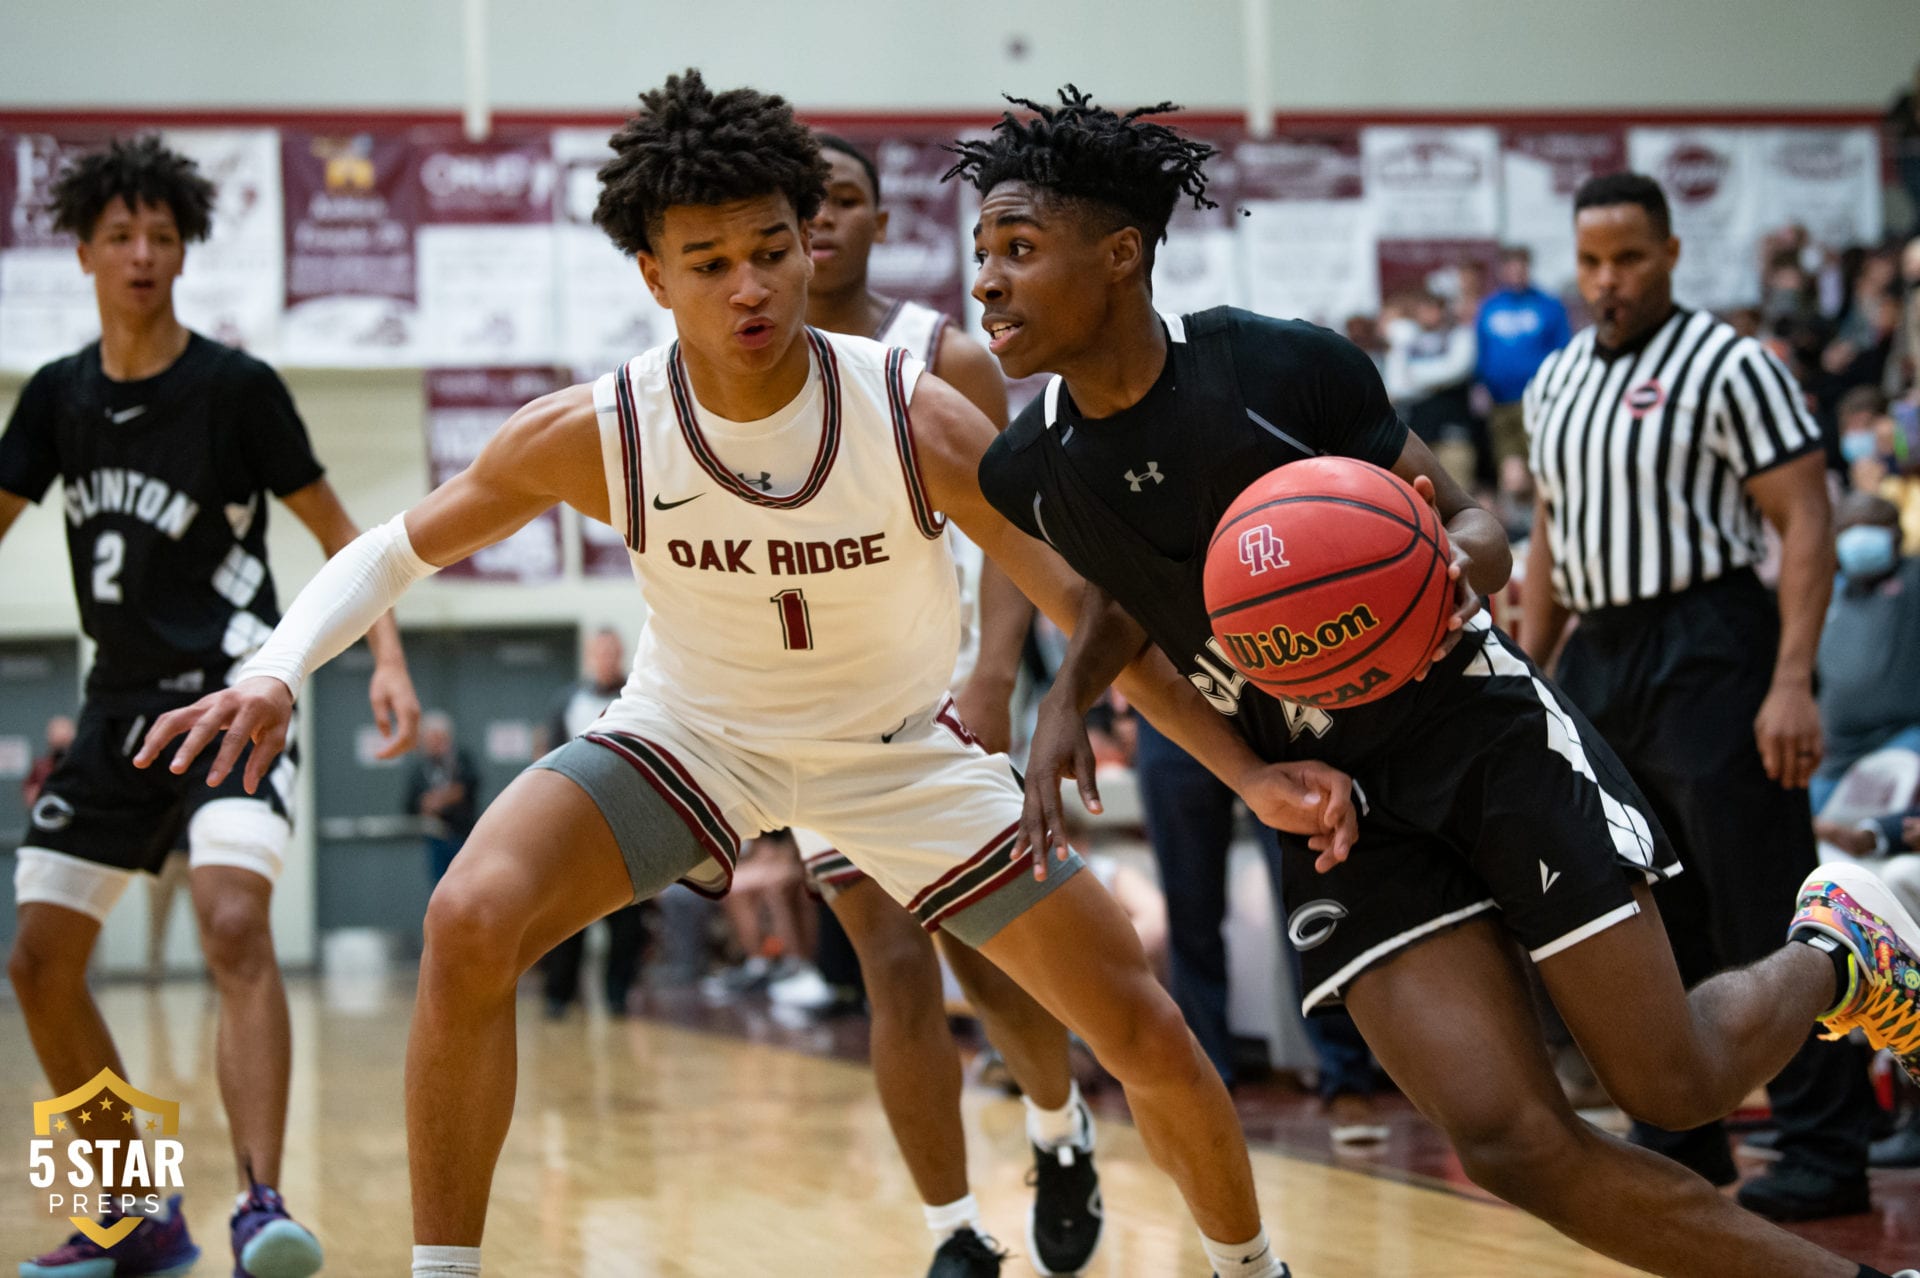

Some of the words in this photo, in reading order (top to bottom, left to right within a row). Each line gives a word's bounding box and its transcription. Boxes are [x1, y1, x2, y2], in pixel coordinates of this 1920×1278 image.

[64, 467, 199, 541] CLINTON
[91, 529, 126, 604] 2
[667, 539, 756, 575] OAK
[767, 532, 890, 576] RIDGE
[769, 588, 813, 650] 1
[1223, 603, 1380, 670] Wilson
[1287, 898, 1349, 952] C
